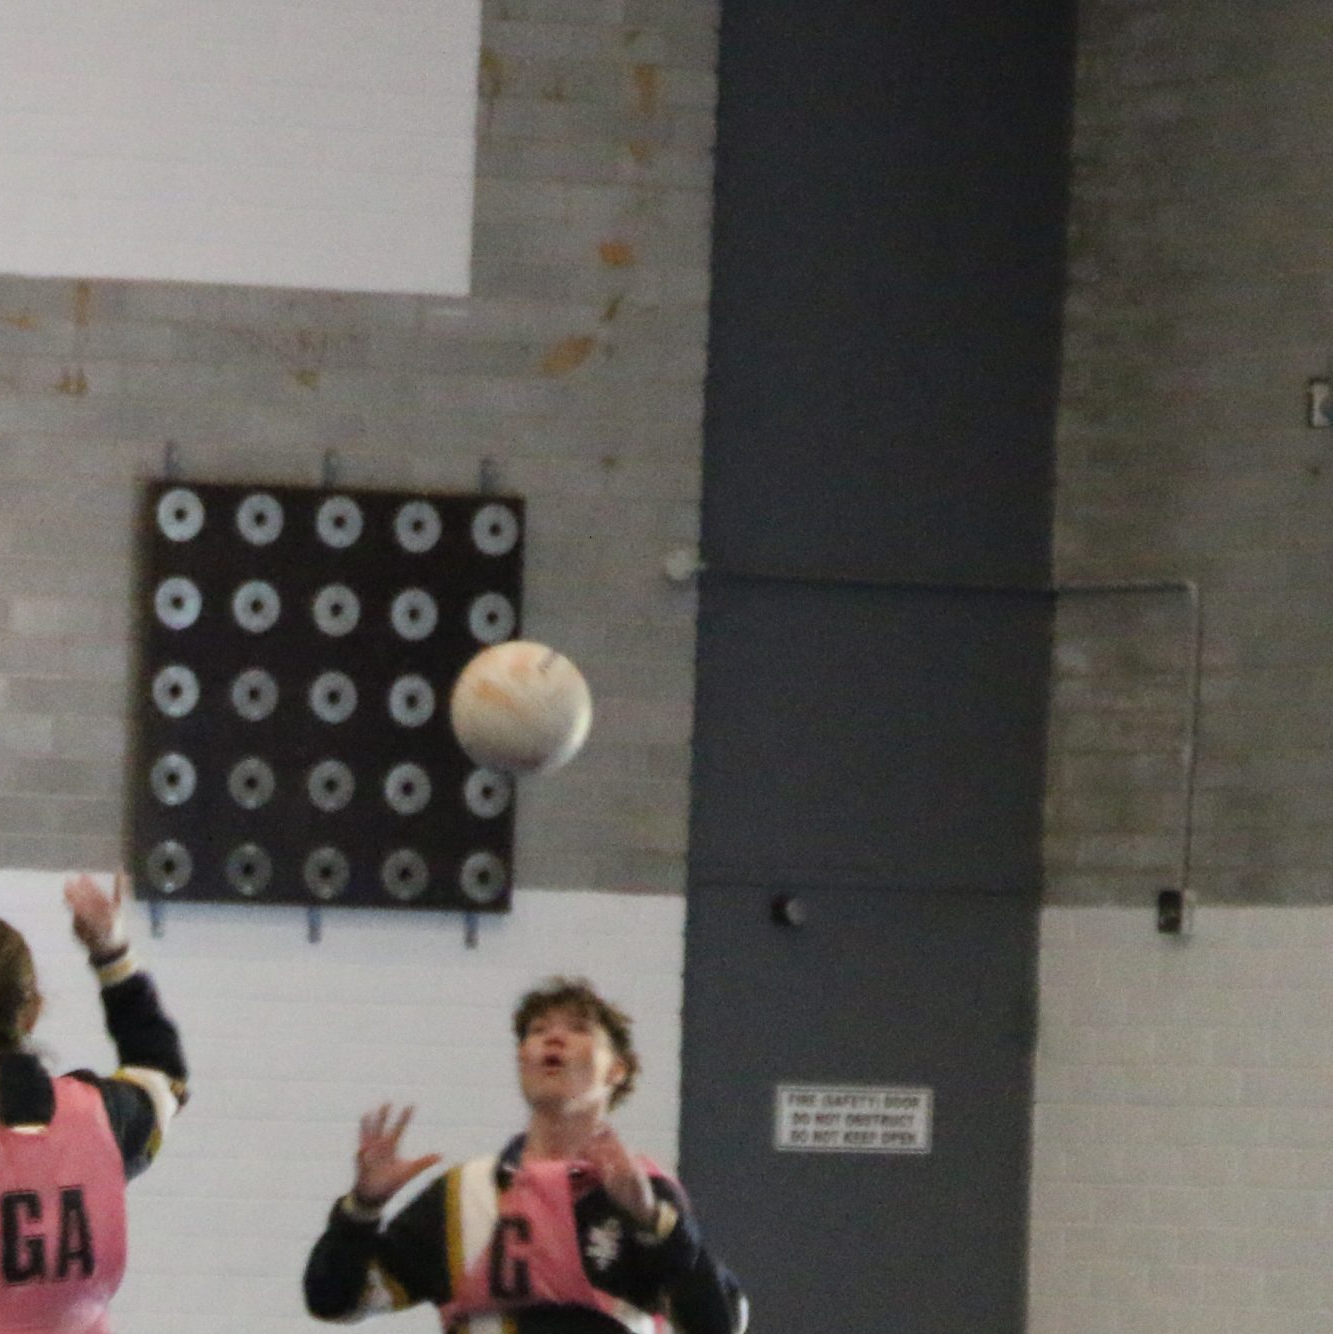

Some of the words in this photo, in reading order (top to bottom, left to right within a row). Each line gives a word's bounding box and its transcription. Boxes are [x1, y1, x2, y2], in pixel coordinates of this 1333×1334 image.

[793, 1112, 810, 1125] DO
[815, 1113, 841, 1126] NOT
[790, 1130, 808, 1143] DO
[813, 1131, 840, 1144] NOT
[882, 1132, 916, 1145] OPEN
[0, 1184, 96, 1287] GA
